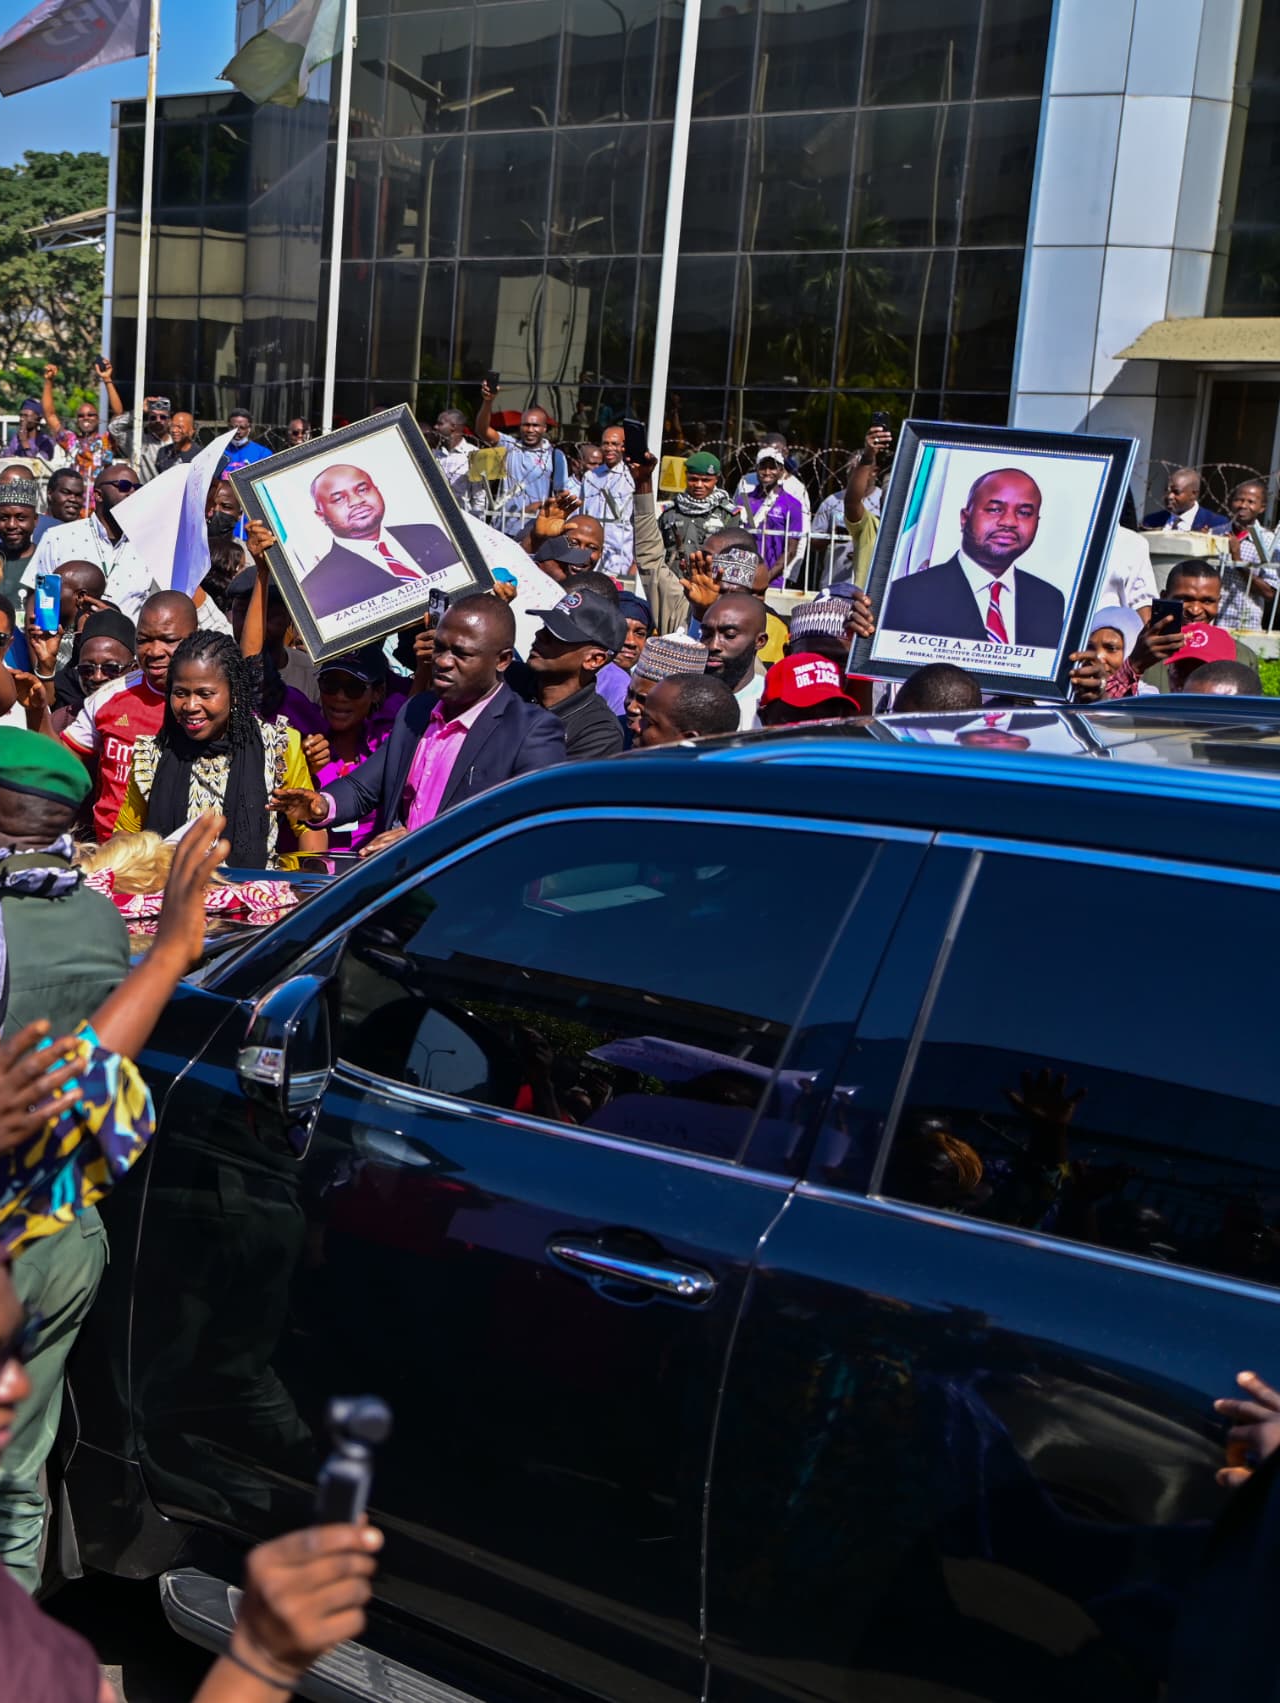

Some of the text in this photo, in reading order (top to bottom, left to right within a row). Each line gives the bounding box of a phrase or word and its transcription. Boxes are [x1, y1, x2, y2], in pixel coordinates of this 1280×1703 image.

[334, 599, 377, 621] ZACCH
[397, 570, 448, 597] ADEDEJI
[899, 634, 1035, 657] ZACCH A. ADEDEJI
[795, 673, 815, 688] DR.
